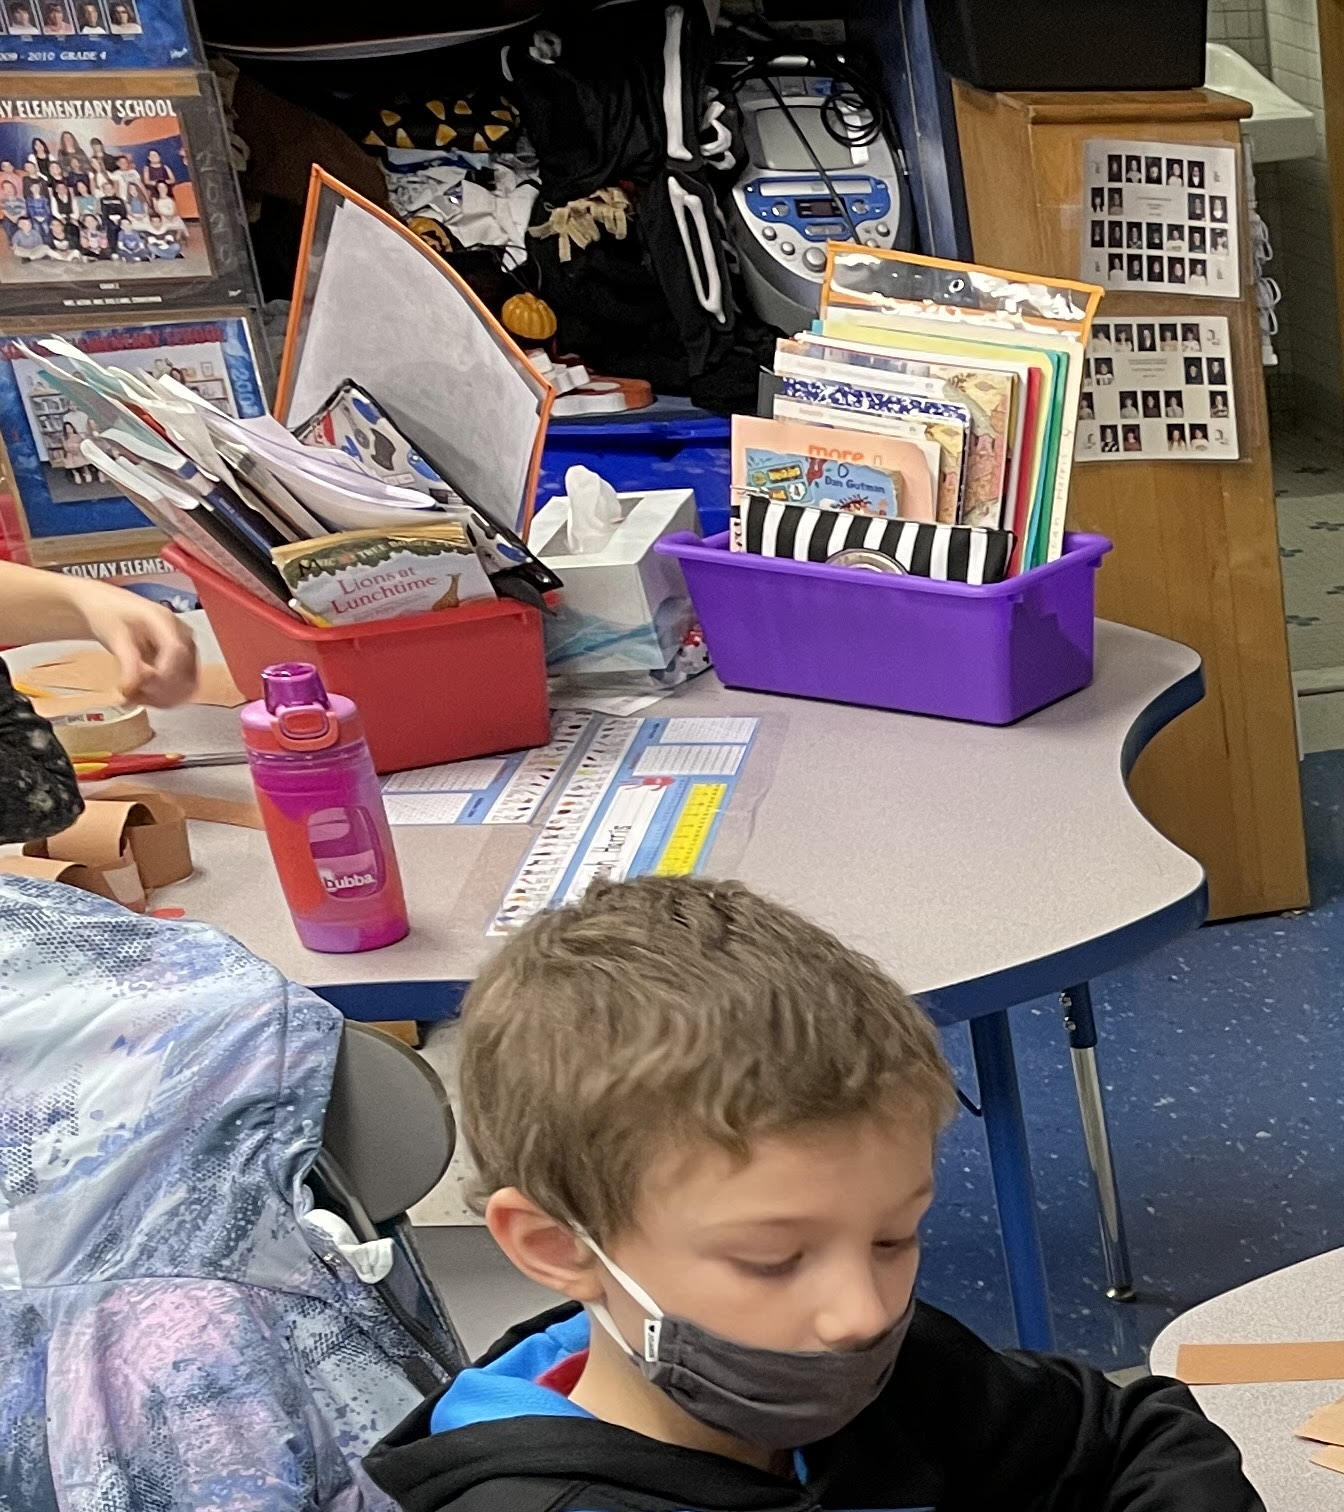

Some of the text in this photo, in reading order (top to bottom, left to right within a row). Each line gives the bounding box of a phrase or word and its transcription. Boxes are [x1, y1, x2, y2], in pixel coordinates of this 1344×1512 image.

[27, 51, 55, 62] 2010
[60, 51, 96, 61] GRADE
[16, 99, 113, 120] ELEMENTARY
[117, 98, 177, 118] SCHOOL
[825, 475, 844, 488] Dan
[120, 558, 177, 577] ELEMEN
[337, 566, 417, 596] Lions at
[330, 575, 440, 616] Lunchtime
